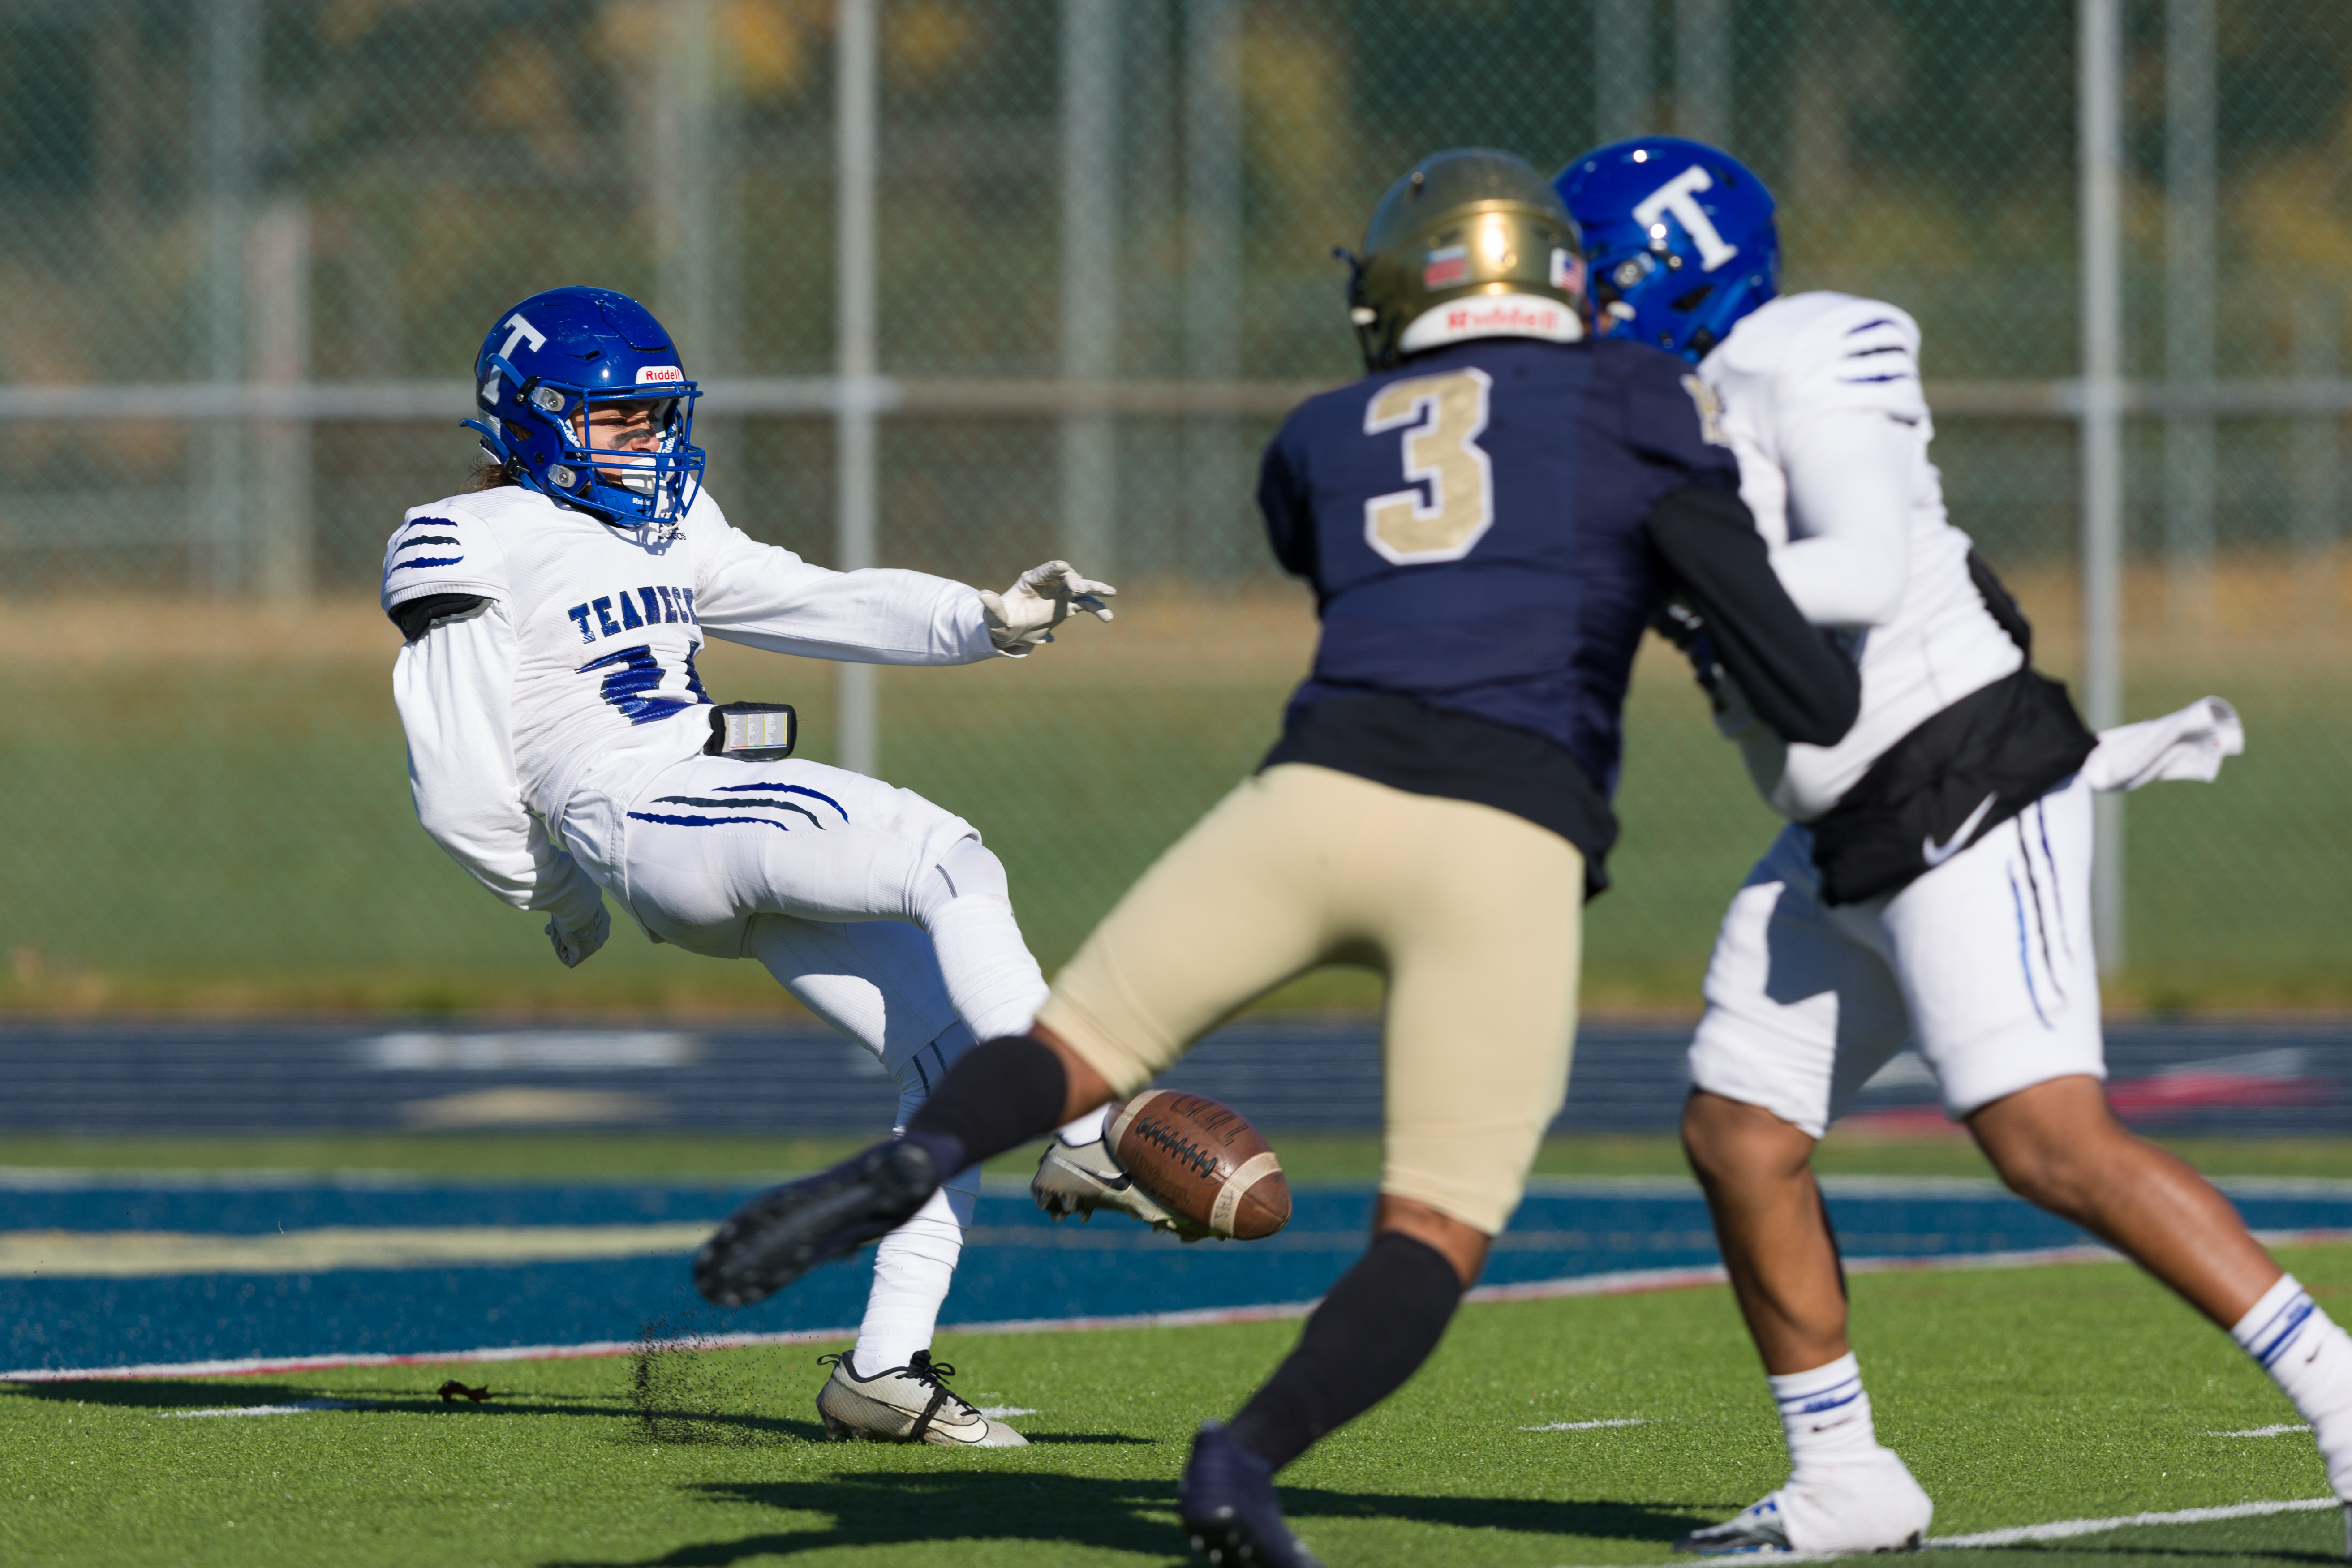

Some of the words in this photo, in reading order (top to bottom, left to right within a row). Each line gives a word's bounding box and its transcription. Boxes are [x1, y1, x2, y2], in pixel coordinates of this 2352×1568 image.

[1632, 165, 1738, 272] T
[482, 313, 547, 405] T
[645, 369, 680, 380] Riddell
[1363, 366, 1494, 564] 3
